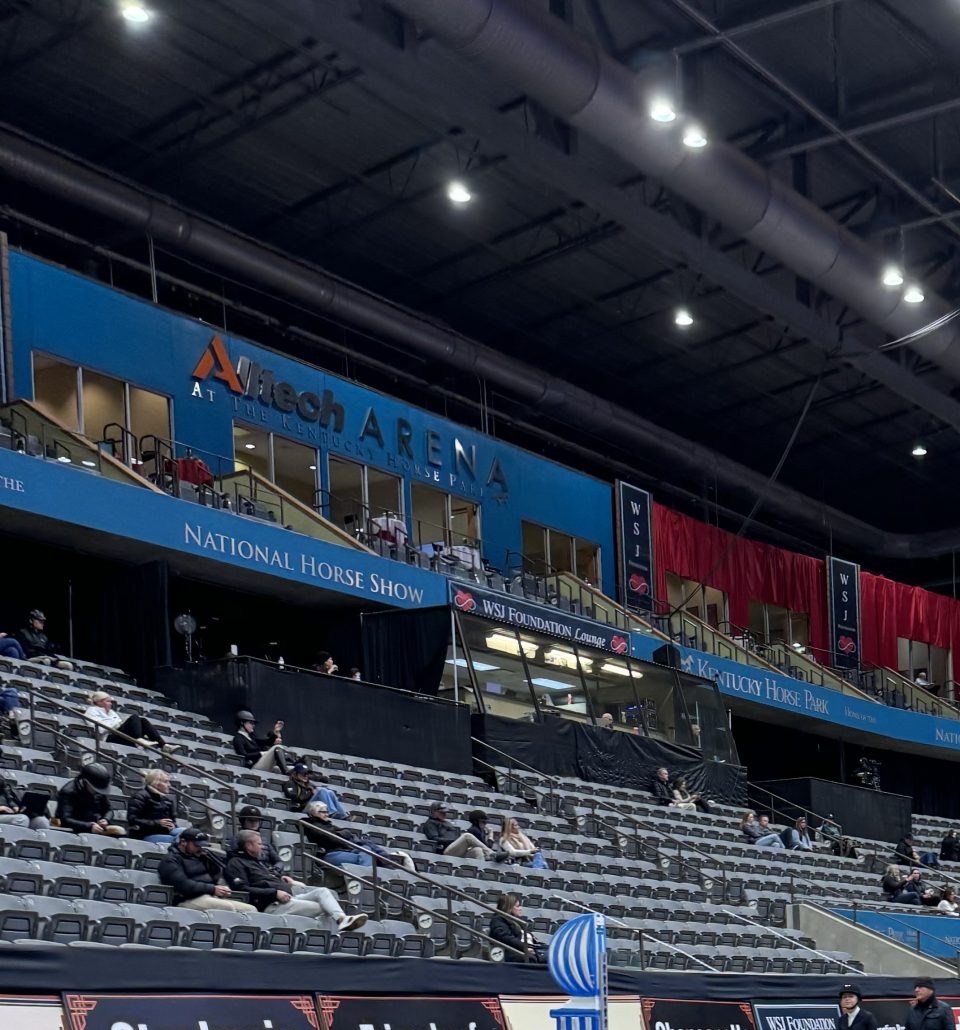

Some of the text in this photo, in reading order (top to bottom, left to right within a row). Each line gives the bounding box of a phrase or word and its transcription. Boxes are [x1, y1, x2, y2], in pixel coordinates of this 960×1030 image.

[191, 382, 215, 402] AT
[231, 396, 266, 422] THE
[281, 415, 374, 460] KENTUCKY
[387, 452, 440, 482] HORSE
[192, 335, 508, 493] Alltech ARENA
[0, 475, 25, 492] HE
[184, 522, 423, 604] NATIONAL HORSE SHOW
[482, 599, 606, 647] WSJ FOUNDATION Lounge
[698, 658, 763, 696] KENTUCKY
[764, 678, 801, 707] HORSE
[805, 689, 829, 715] PARK
[785, 1016, 836, 1030] FOUNDATION
